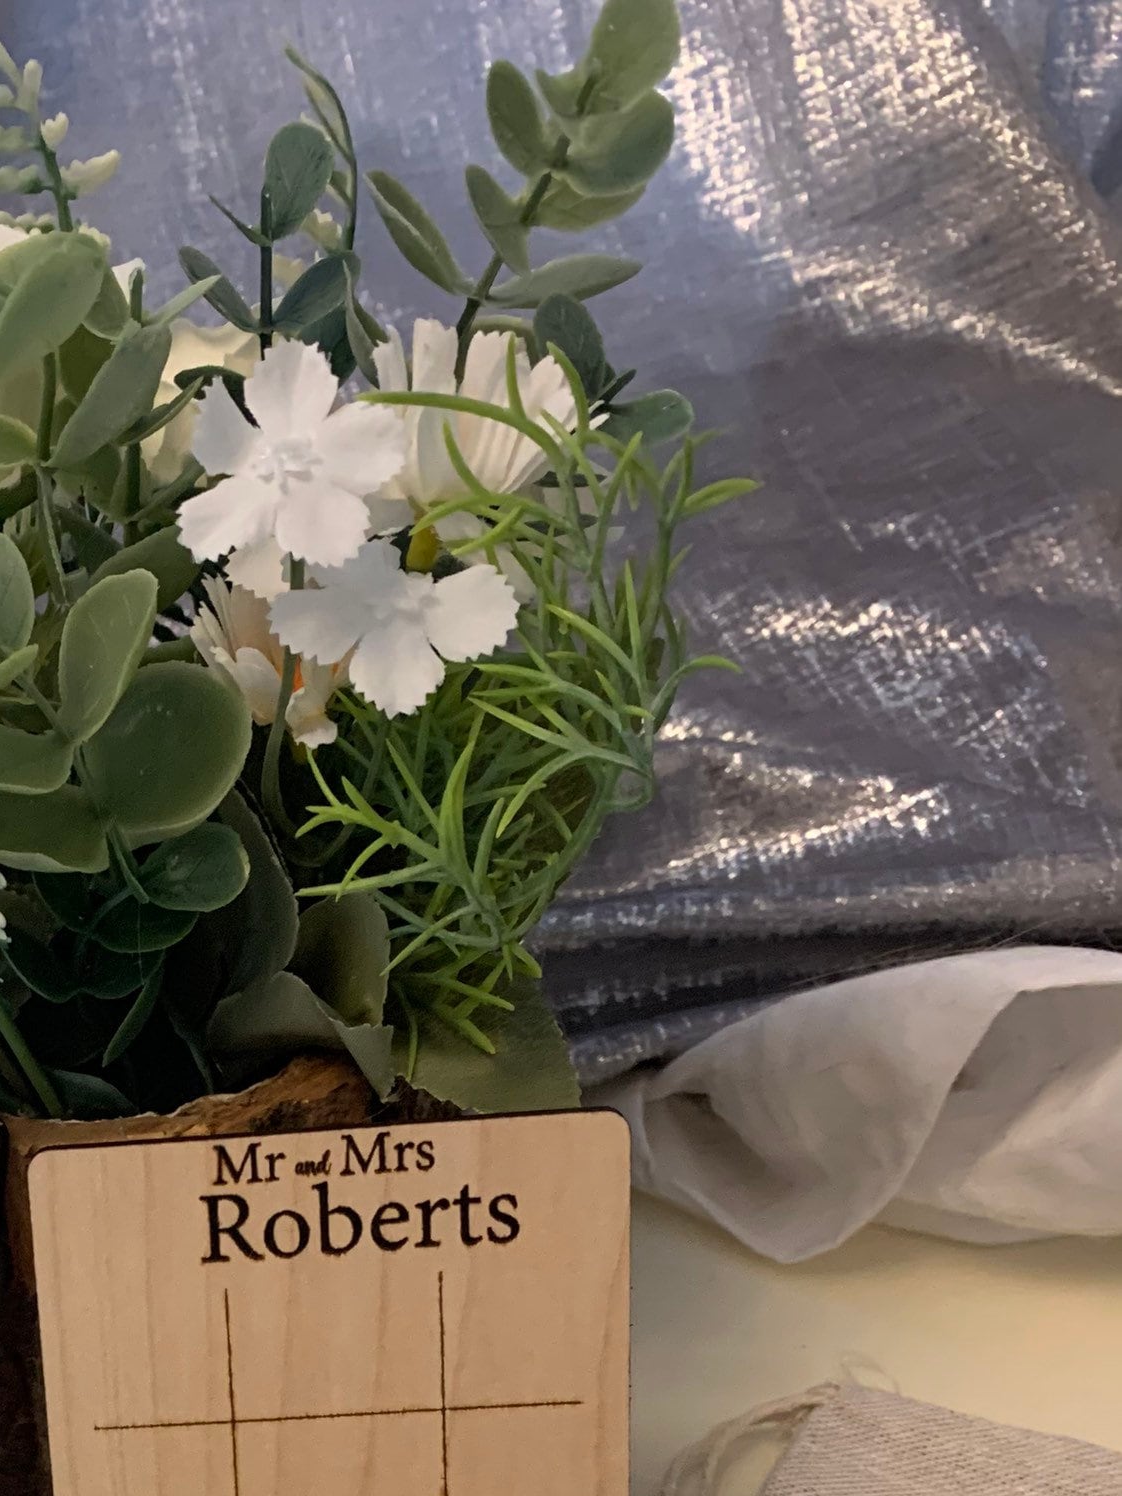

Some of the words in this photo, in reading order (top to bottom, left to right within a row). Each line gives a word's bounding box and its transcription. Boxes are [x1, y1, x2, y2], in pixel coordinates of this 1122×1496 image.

[212, 1142, 286, 1186] Mr
[294, 1149, 332, 1176] and
[340, 1131, 436, 1177] Mrs
[199, 1180, 520, 1264] Roberts
